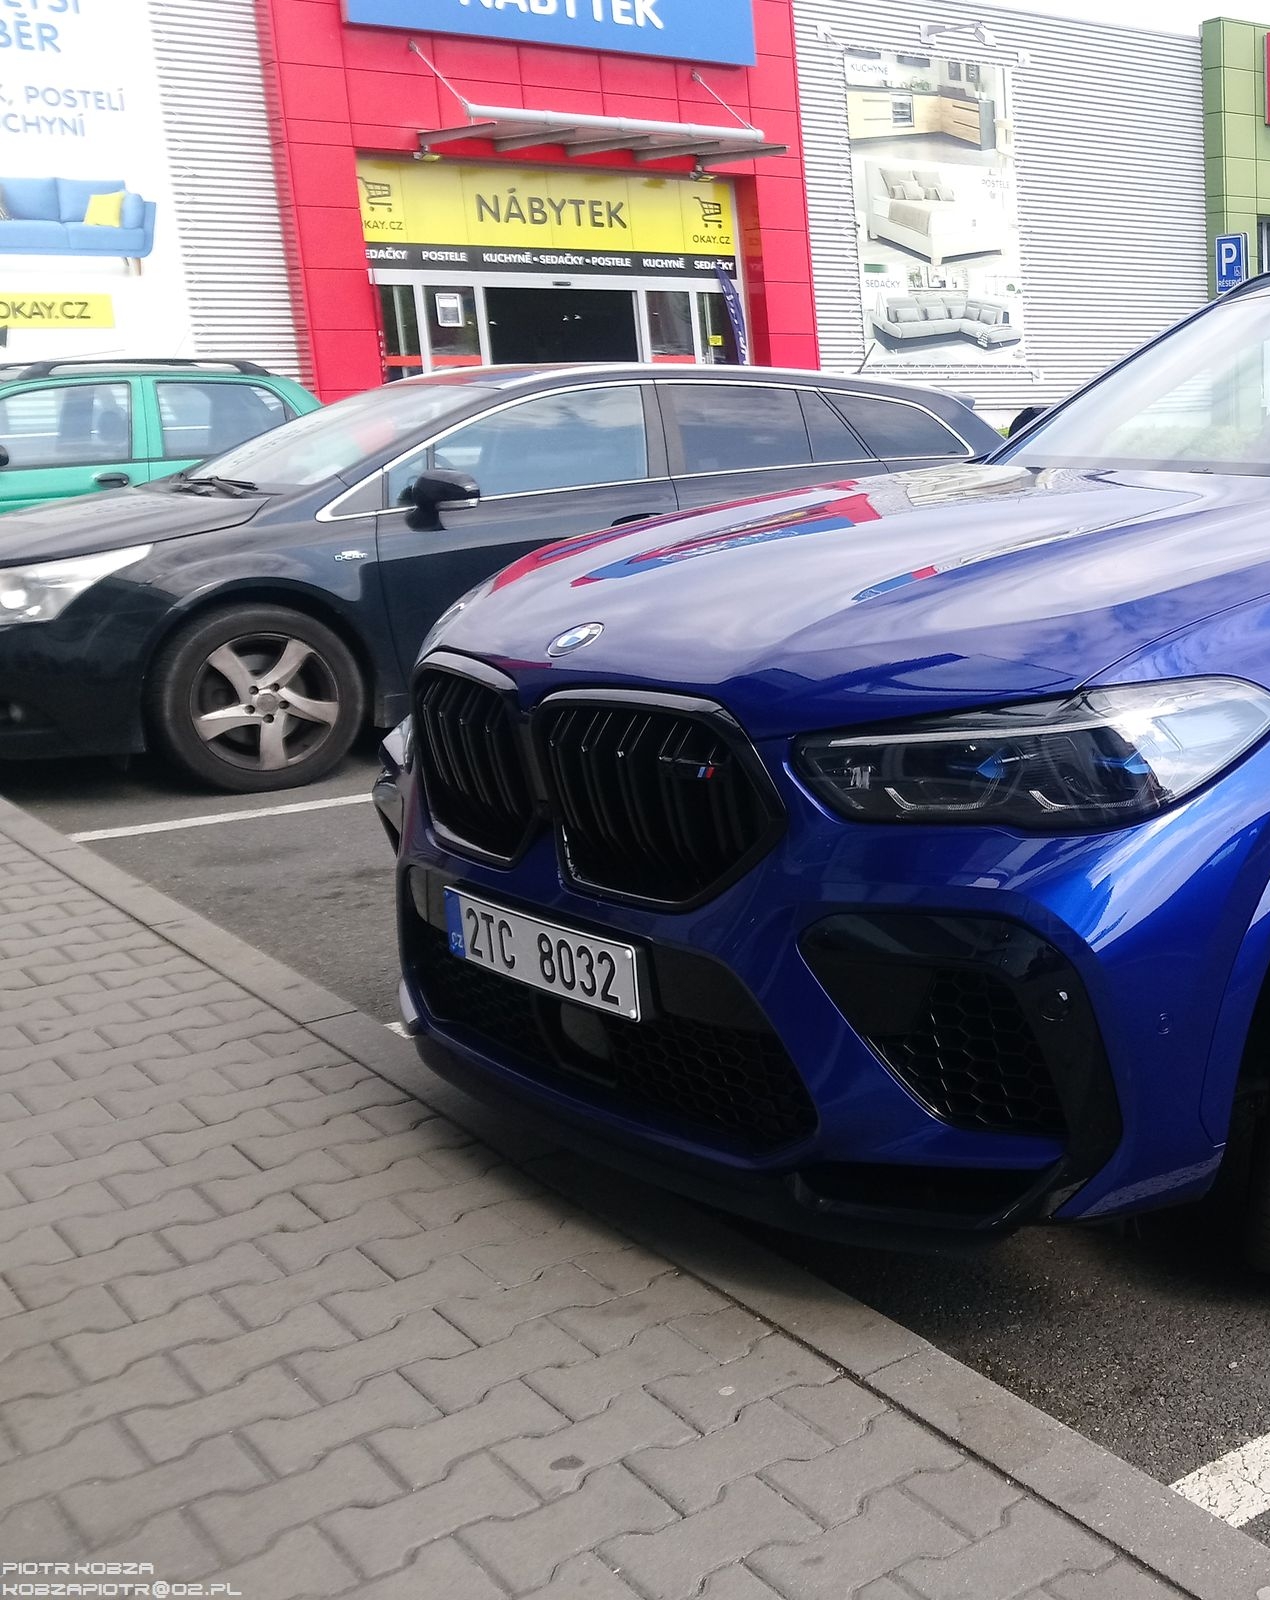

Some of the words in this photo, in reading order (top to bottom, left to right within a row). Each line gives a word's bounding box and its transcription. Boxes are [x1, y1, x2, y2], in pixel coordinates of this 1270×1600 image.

[24, 85, 125, 111] POSTELÍ
[475, 187, 627, 229] NÁBYTEK
[363, 219, 404, 231] KAY.CZ
[692, 234, 731, 245] OKAY.CZ
[365, 247, 408, 260] EDAČKY
[422, 250, 468, 262] POSTELE
[483, 251, 533, 265] KUCHYNĚ
[539, 253, 584, 266] SEDAČKY
[592, 256, 632, 268] POSTELE
[642, 257, 686, 269] KUCHYNĚ
[1221, 243, 1237, 276] P
[864, 278, 901, 289] SEDAČKY
[466, 907, 515, 969] 2TC
[537, 932, 620, 1006] 8032
